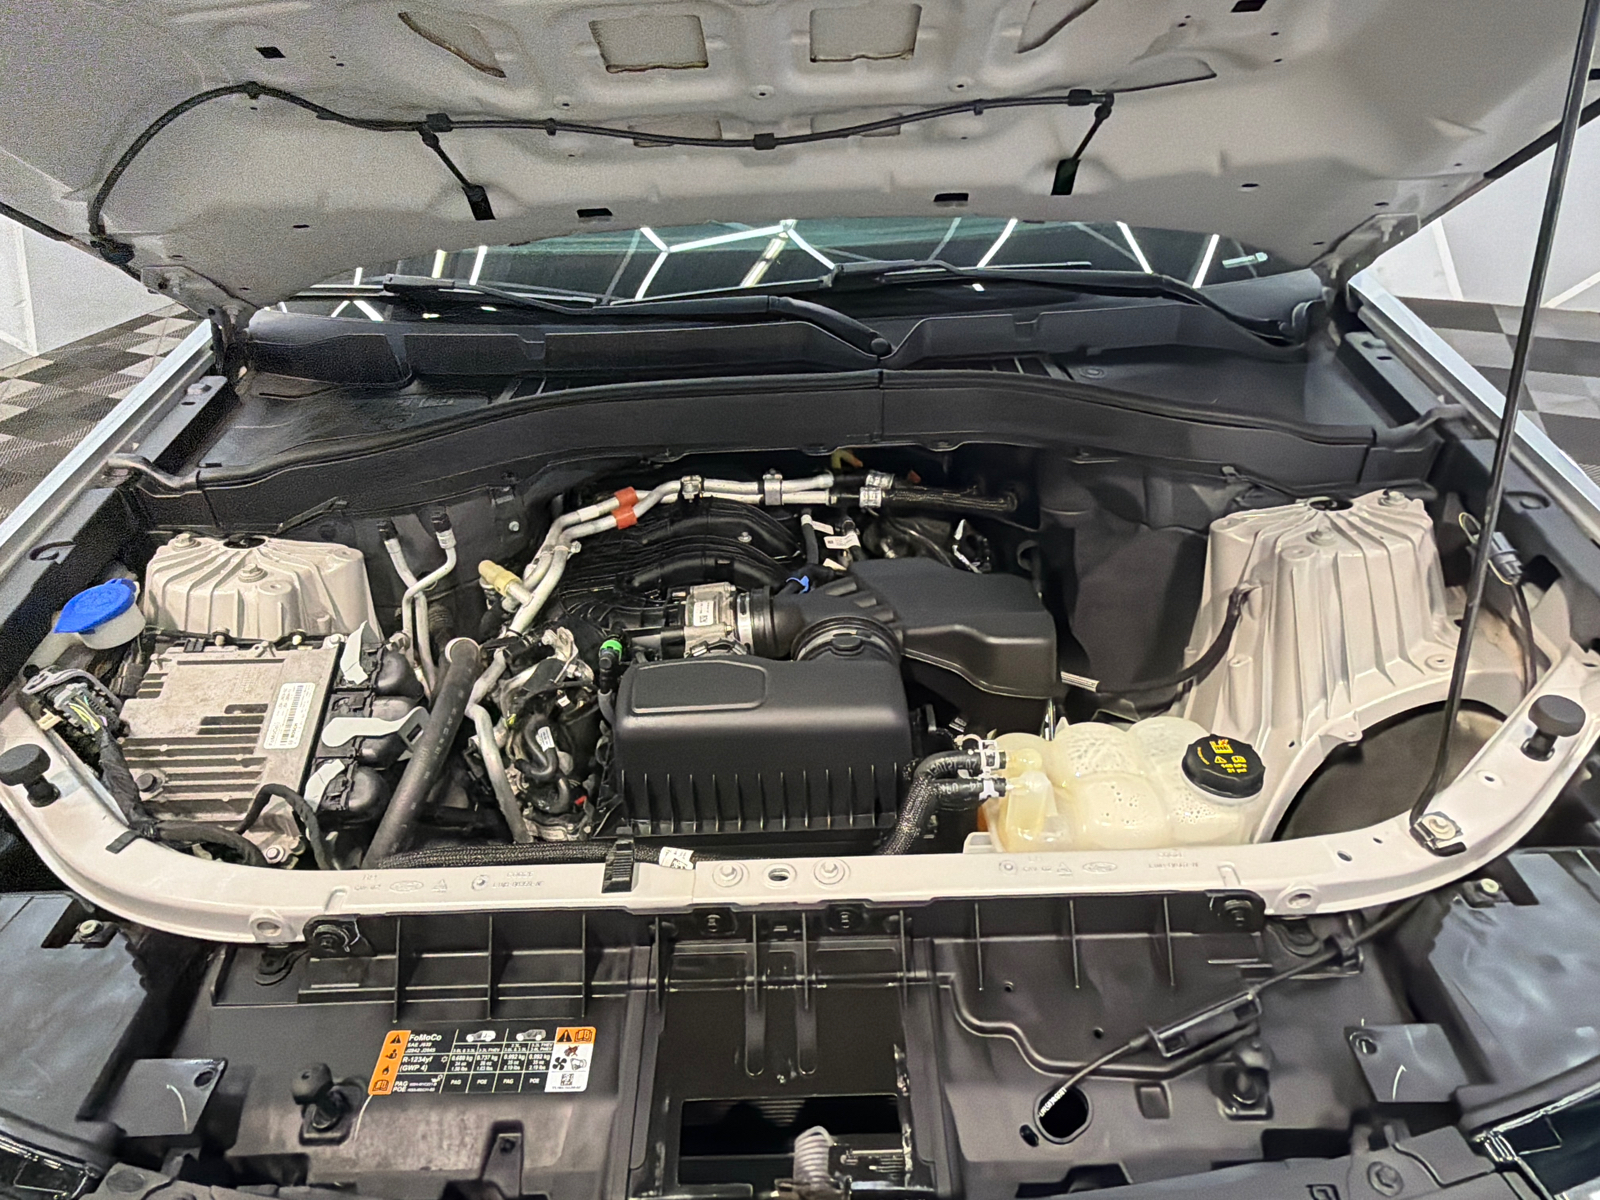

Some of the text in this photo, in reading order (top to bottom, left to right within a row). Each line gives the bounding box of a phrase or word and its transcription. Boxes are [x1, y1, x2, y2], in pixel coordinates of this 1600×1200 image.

[408, 1034, 443, 1042] FoMoCo
[402, 1056, 433, 1064] R-1234yf
[400, 1064, 428, 1072] (GWP 4)
